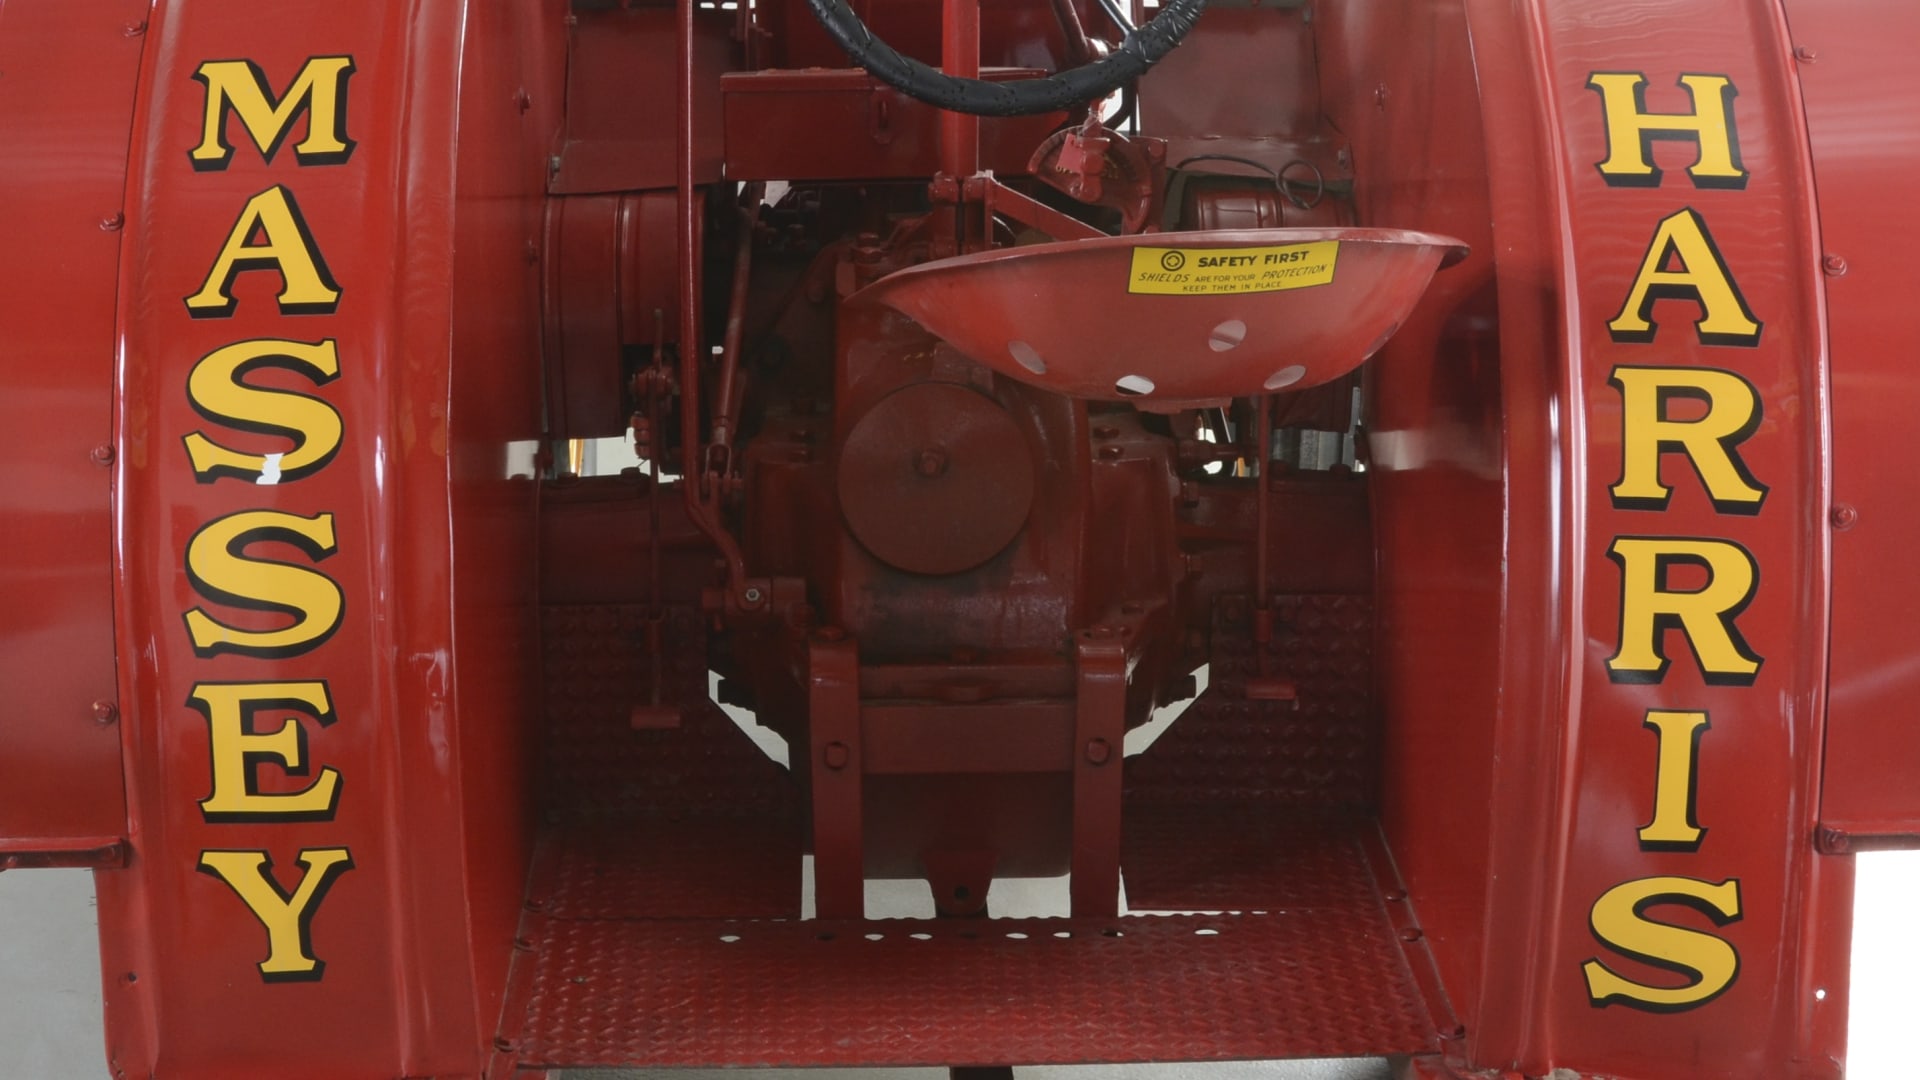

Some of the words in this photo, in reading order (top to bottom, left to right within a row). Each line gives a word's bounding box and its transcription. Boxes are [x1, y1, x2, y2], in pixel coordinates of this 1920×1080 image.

[1198, 256, 1258, 268] SAFETY
[1264, 250, 1310, 265] FIRST
[1138, 271, 1191, 283] SHIELDS
[1194, 275, 1211, 283] ARE
[1213, 274, 1231, 282] FOR
[1233, 273, 1256, 282] YOUR
[1261, 263, 1328, 280] PROTECTION
[1212, 284, 1237, 292] THEM
[1240, 282, 1251, 291] IN
[1254, 281, 1282, 290] PLACE
[183, 55, 356, 982] MASSEY
[1581, 71, 1769, 1014] HARRIS
